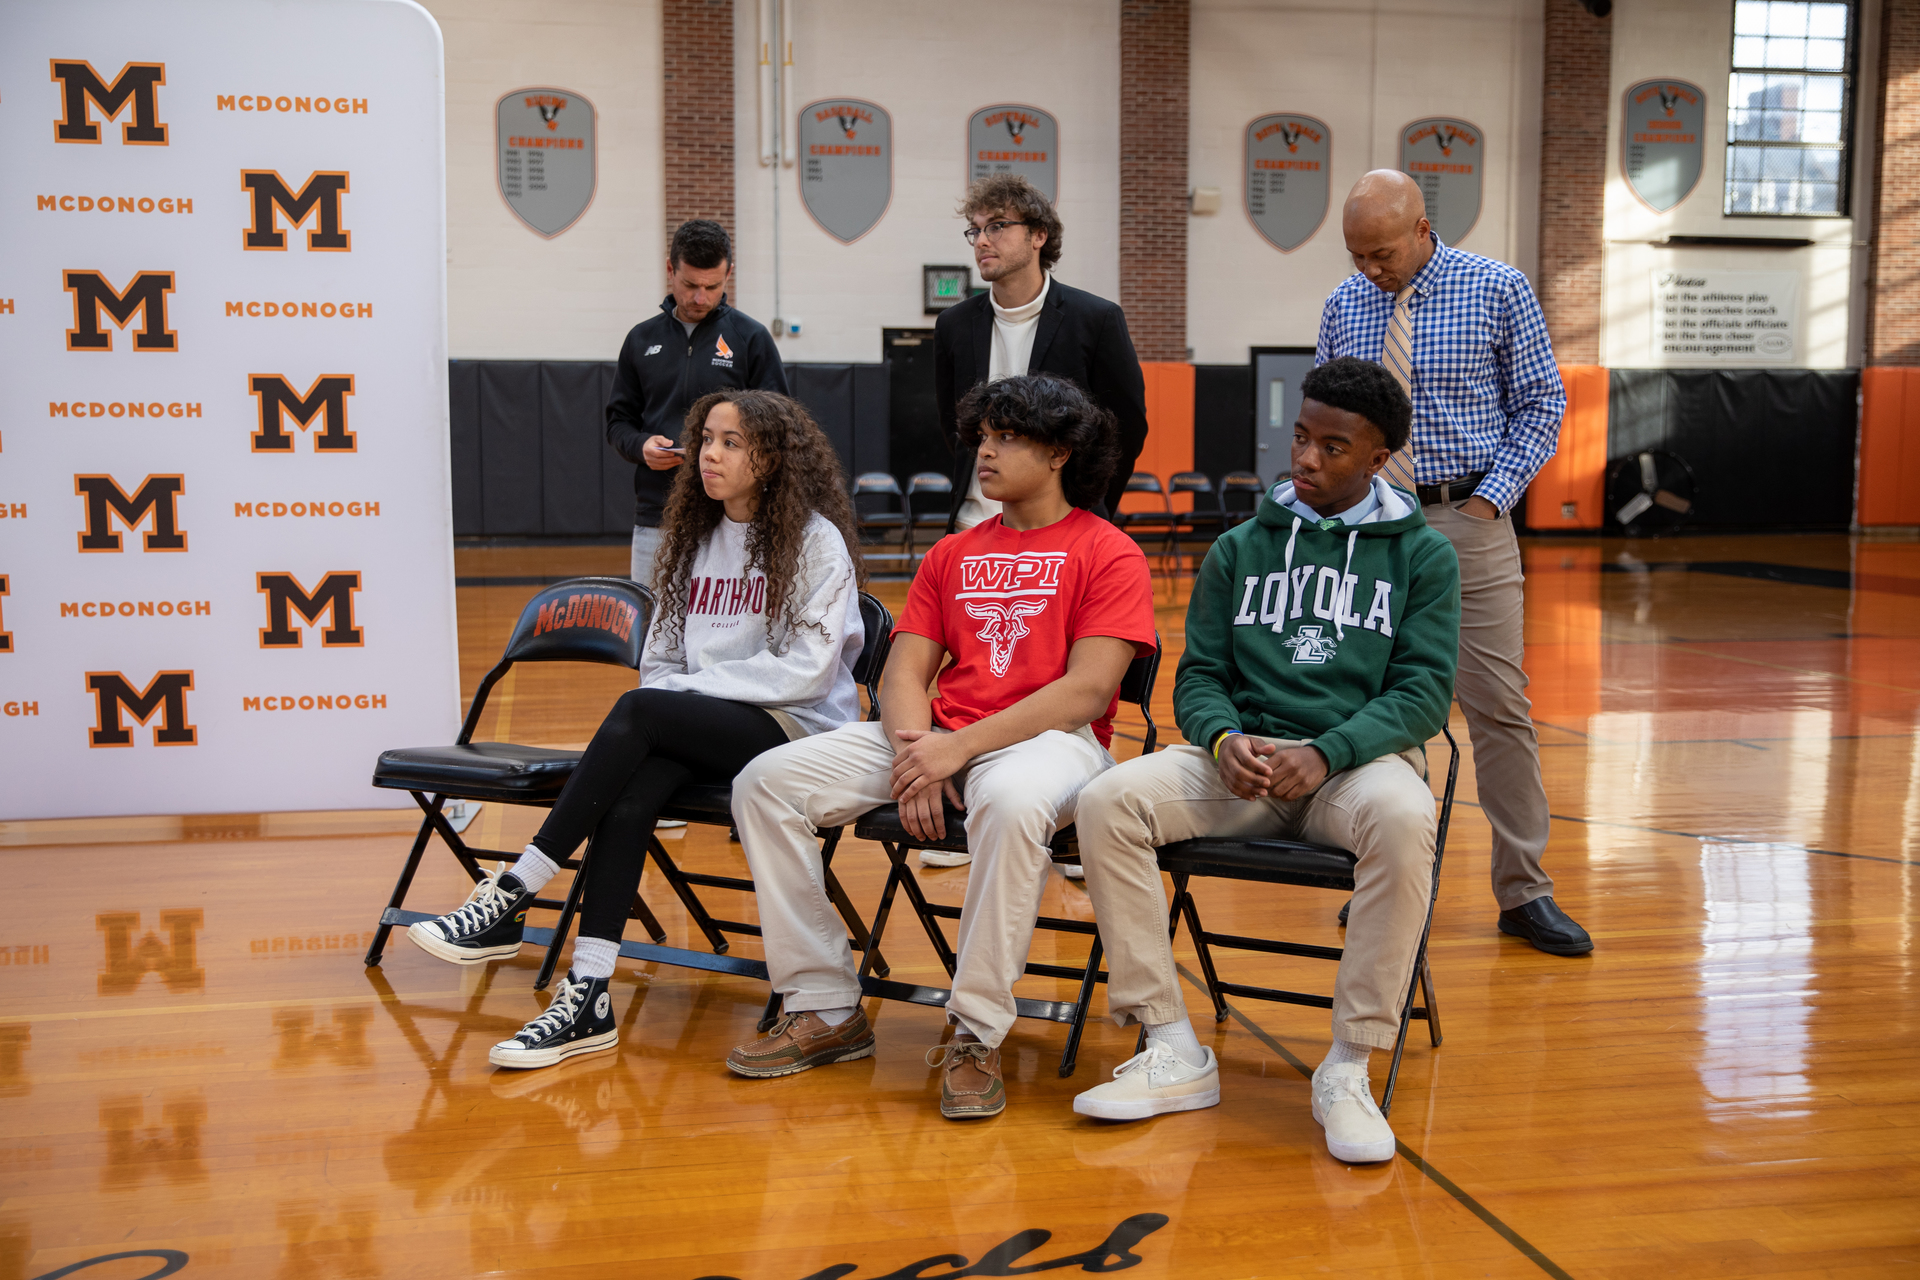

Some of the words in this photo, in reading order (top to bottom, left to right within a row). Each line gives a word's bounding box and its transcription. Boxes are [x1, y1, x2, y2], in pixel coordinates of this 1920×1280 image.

[49, 58, 169, 146] M
[217, 95, 369, 114] MCDONOGH
[815, 105, 874, 124] BASEBALL
[508, 136, 585, 150] CHAMPIONS
[810, 145, 881, 156] CHAMPIONS
[978, 151, 1048, 162] CHAMPIONS
[1255, 159, 1321, 172] CHAMPIONS
[1408, 161, 1474, 175] CHAMPIONS
[37, 195, 194, 214] MCDONOGH
[240, 169, 352, 253] M
[1682, 292, 1698, 301] the
[1746, 292, 1770, 304] play
[62, 269, 179, 352] M
[225, 302, 373, 318] MCDONOGH
[1681, 305, 1698, 315] the
[1746, 306, 1778, 315] coach
[1681, 319, 1697, 329] the
[1680, 332, 1697, 341] the
[1664, 345, 1756, 355] encouragement
[49, 402, 202, 418] MCDONOGH
[248, 373, 357, 453] M
[74, 473, 188, 553] M
[235, 502, 381, 517] MCDONOGH
[960, 559, 1065, 590] WPI
[686, 576, 782, 621] WARTHMO
[1233, 564, 1394, 639] LOYOLA
[60, 601, 211, 617] MCDONOGH
[256, 570, 365, 649] M
[84, 669, 198, 749] M
[243, 694, 387, 711] MCDONOGH
